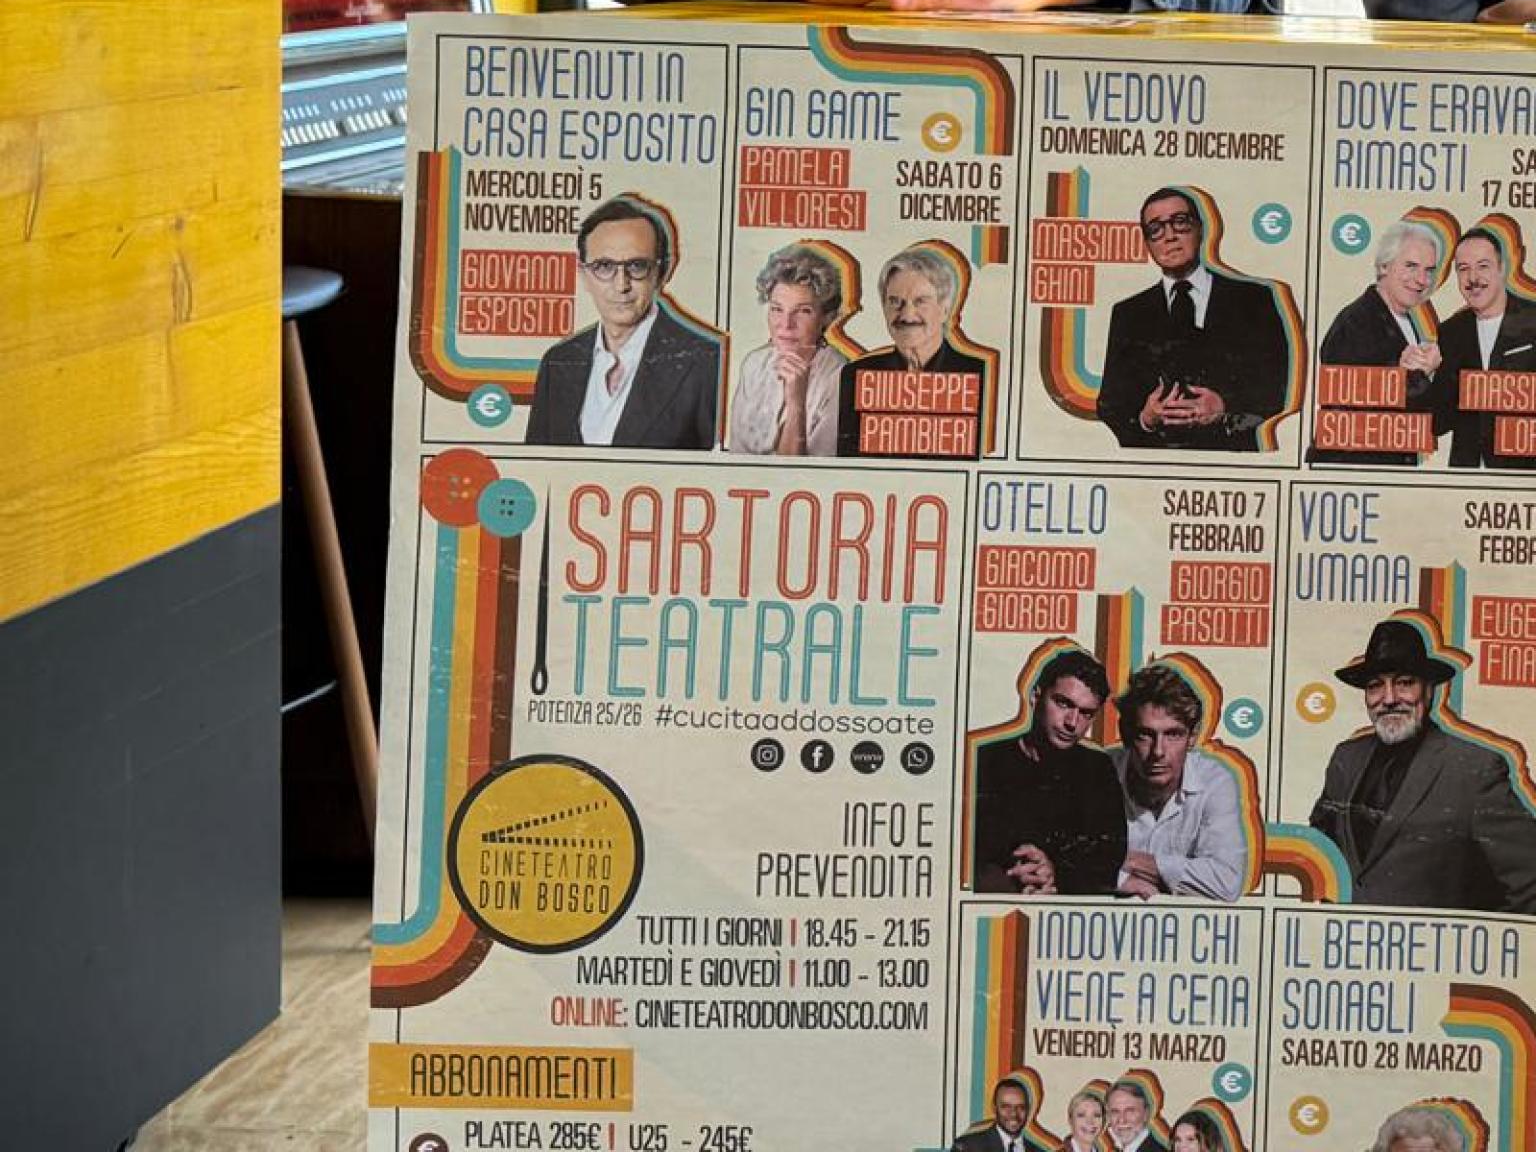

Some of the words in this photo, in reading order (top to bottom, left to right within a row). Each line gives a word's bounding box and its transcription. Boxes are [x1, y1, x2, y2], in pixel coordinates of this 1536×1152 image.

[466, 46, 643, 102] BENVENUTI
[657, 52, 684, 103] IN
[746, 88, 794, 137] GIN
[807, 89, 902, 141] GAME
[1043, 69, 1069, 120] IL
[1085, 71, 1205, 125] VEDOVO
[1337, 80, 1418, 131] DOVE
[464, 107, 547, 159] CASA
[559, 110, 717, 164] ESPOSITO
[1040, 126, 1146, 157] DOMENICA
[1154, 130, 1177, 157] 28
[1185, 131, 1285, 161] DICEMBRE
[466, 165, 584, 200] MERCOLEDÌ
[589, 173, 602, 200] 5
[746, 148, 842, 185] PAMELA
[897, 160, 982, 189] SABATO
[988, 163, 1002, 190] 6
[1335, 139, 1467, 192] RIMASTI
[745, 190, 860, 228] VILLORESI
[900, 193, 1000, 223] DICEMBRE
[1482, 180, 1501, 208] 17
[465, 203, 580, 235] NOVEMBRE
[1036, 222, 1143, 260] MASSIMO
[464, 252, 567, 291] GIOVANNI
[1035, 266, 1089, 302] GHINI
[462, 296, 573, 334] ESPOSITO
[1325, 368, 1399, 405] TULLIO
[865, 415, 976, 455] PAMBIERI
[1322, 413, 1427, 450] SOLENGHI
[983, 481, 1107, 535] OTELLO
[1163, 489, 1247, 518] SABATO
[1253, 493, 1266, 519] 7
[1299, 491, 1380, 544] VOCE
[565, 483, 949, 604] SARTORIA
[1168, 522, 1264, 554] FEBBRAIO
[986, 549, 1089, 589] GIACOMO
[1178, 565, 1263, 602] GIORGIO
[1295, 552, 1410, 604] UMANA
[984, 593, 1069, 631] GIORGIO
[1167, 607, 1262, 645] PASOTTI
[562, 594, 941, 707] TEATRALE
[528, 700, 592, 726] POTENZA
[596, 701, 643, 727] 25/26
[654, 704, 935, 735] #cucitaaddossoate
[843, 802, 905, 848] INFO
[918, 803, 933, 848] E
[480, 849, 612, 880] CINETEATRO
[755, 853, 932, 898] PREVENDITA
[479, 880, 521, 910] DON
[537, 882, 610, 914] BOSCO
[636, 915, 697, 946] TUTTI
[703, 916, 709, 946] I
[715, 916, 782, 947] GIORNI
[804, 919, 857, 947] 18.45
[882, 919, 930, 947] 21.15
[1037, 910, 1179, 963] INDOVINA
[1191, 914, 1239, 964] CHI
[1285, 917, 1310, 968] IL
[1324, 918, 1489, 975] BERRETTO
[1501, 928, 1520, 979] A
[577, 950, 673, 986] MARTEDÌ
[681, 958, 692, 986] E
[700, 951, 782, 987] GIOVEDÌ
[804, 959, 850, 988] 11.00
[877, 959, 929, 988] 13.00
[551, 996, 628, 1028] ONLINE:
[635, 999, 929, 1030] CINETEATRODONBOSCO.COM
[1037, 969, 1125, 1023] VIENE
[1138, 973, 1157, 1024] A
[1169, 974, 1249, 1027] CENA
[1282, 978, 1414, 1034] SONAGLI
[1033, 1025, 1116, 1058] VENERDÌ
[1123, 1032, 1142, 1060] 13
[1149, 1033, 1225, 1062] MARZO
[1282, 1038, 1367, 1069] SABATO
[1375, 1042, 1399, 1070] 28
[1405, 1043, 1483, 1073] MARZO
[410, 1053, 616, 1100] ABBONAMENTI
[465, 1121, 540, 1149] PLATEA
[550, 1122, 600, 1151] 285€
[629, 1125, 668, 1151] U25
[700, 1126, 753, 1152] 245€
